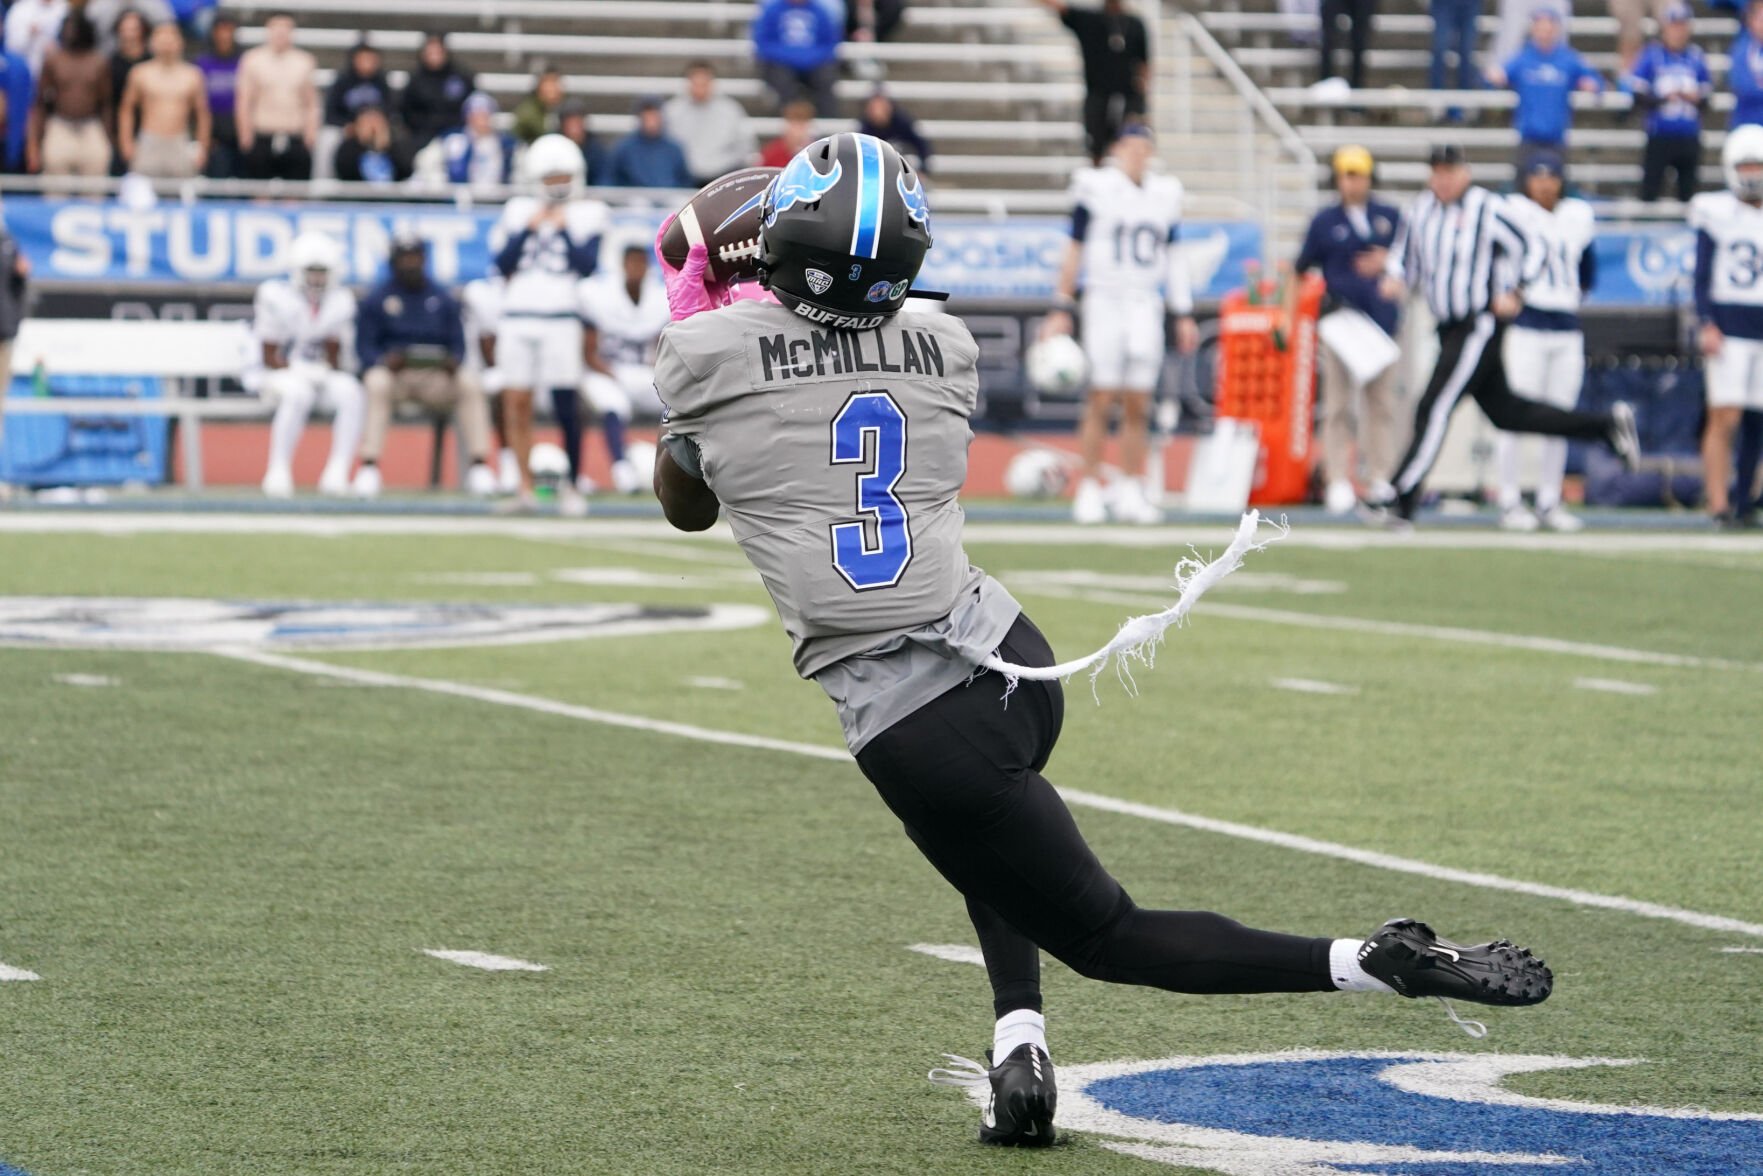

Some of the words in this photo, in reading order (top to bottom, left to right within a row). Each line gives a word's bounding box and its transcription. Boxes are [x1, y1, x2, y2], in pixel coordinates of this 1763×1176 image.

[807, 275, 830, 287] MAC
[849, 264, 862, 281] 3
[1728, 239, 1763, 290] 3
[794, 302, 885, 329] BUFFALO
[758, 328, 944, 381] McMILLAN
[829, 389, 914, 593] 3
